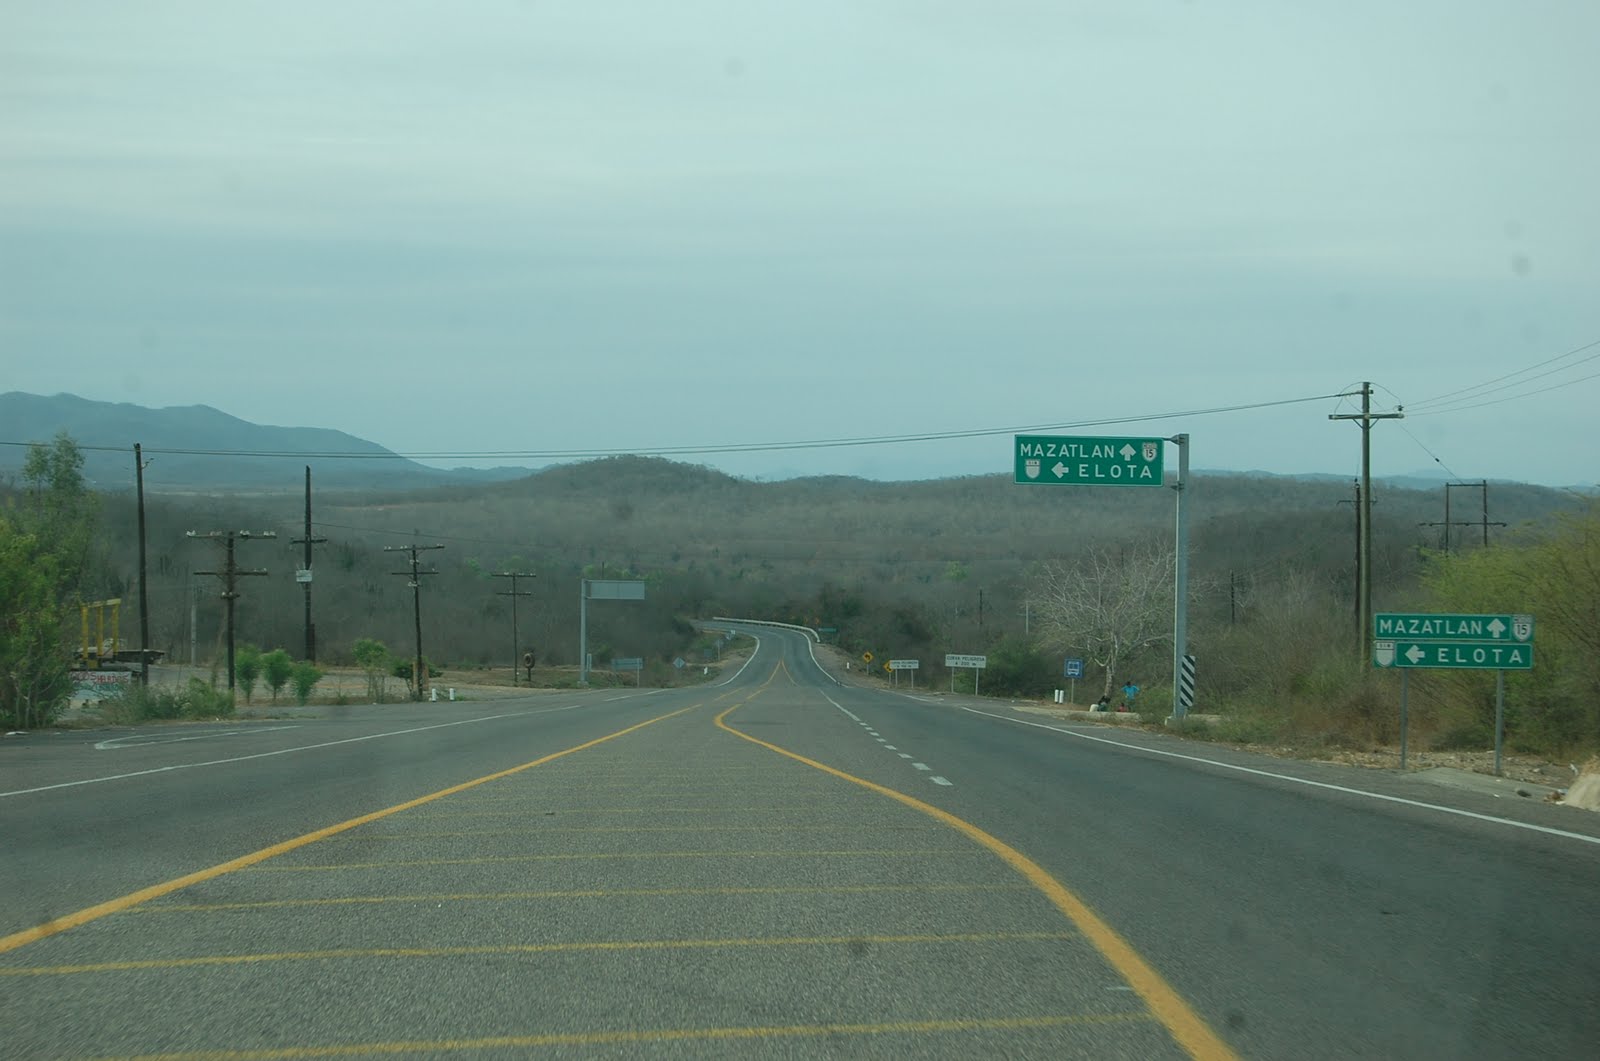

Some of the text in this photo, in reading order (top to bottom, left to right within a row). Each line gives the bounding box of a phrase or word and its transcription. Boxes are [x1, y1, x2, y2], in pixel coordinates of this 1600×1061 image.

[1020, 443, 1115, 459] MAZATLAN
[1145, 448, 1154, 459] 15
[1078, 463, 1153, 479] ELOTA
[1379, 619, 1482, 635] MAZATLAN
[1516, 624, 1528, 636] 15
[1437, 647, 1524, 664] ELOTA
